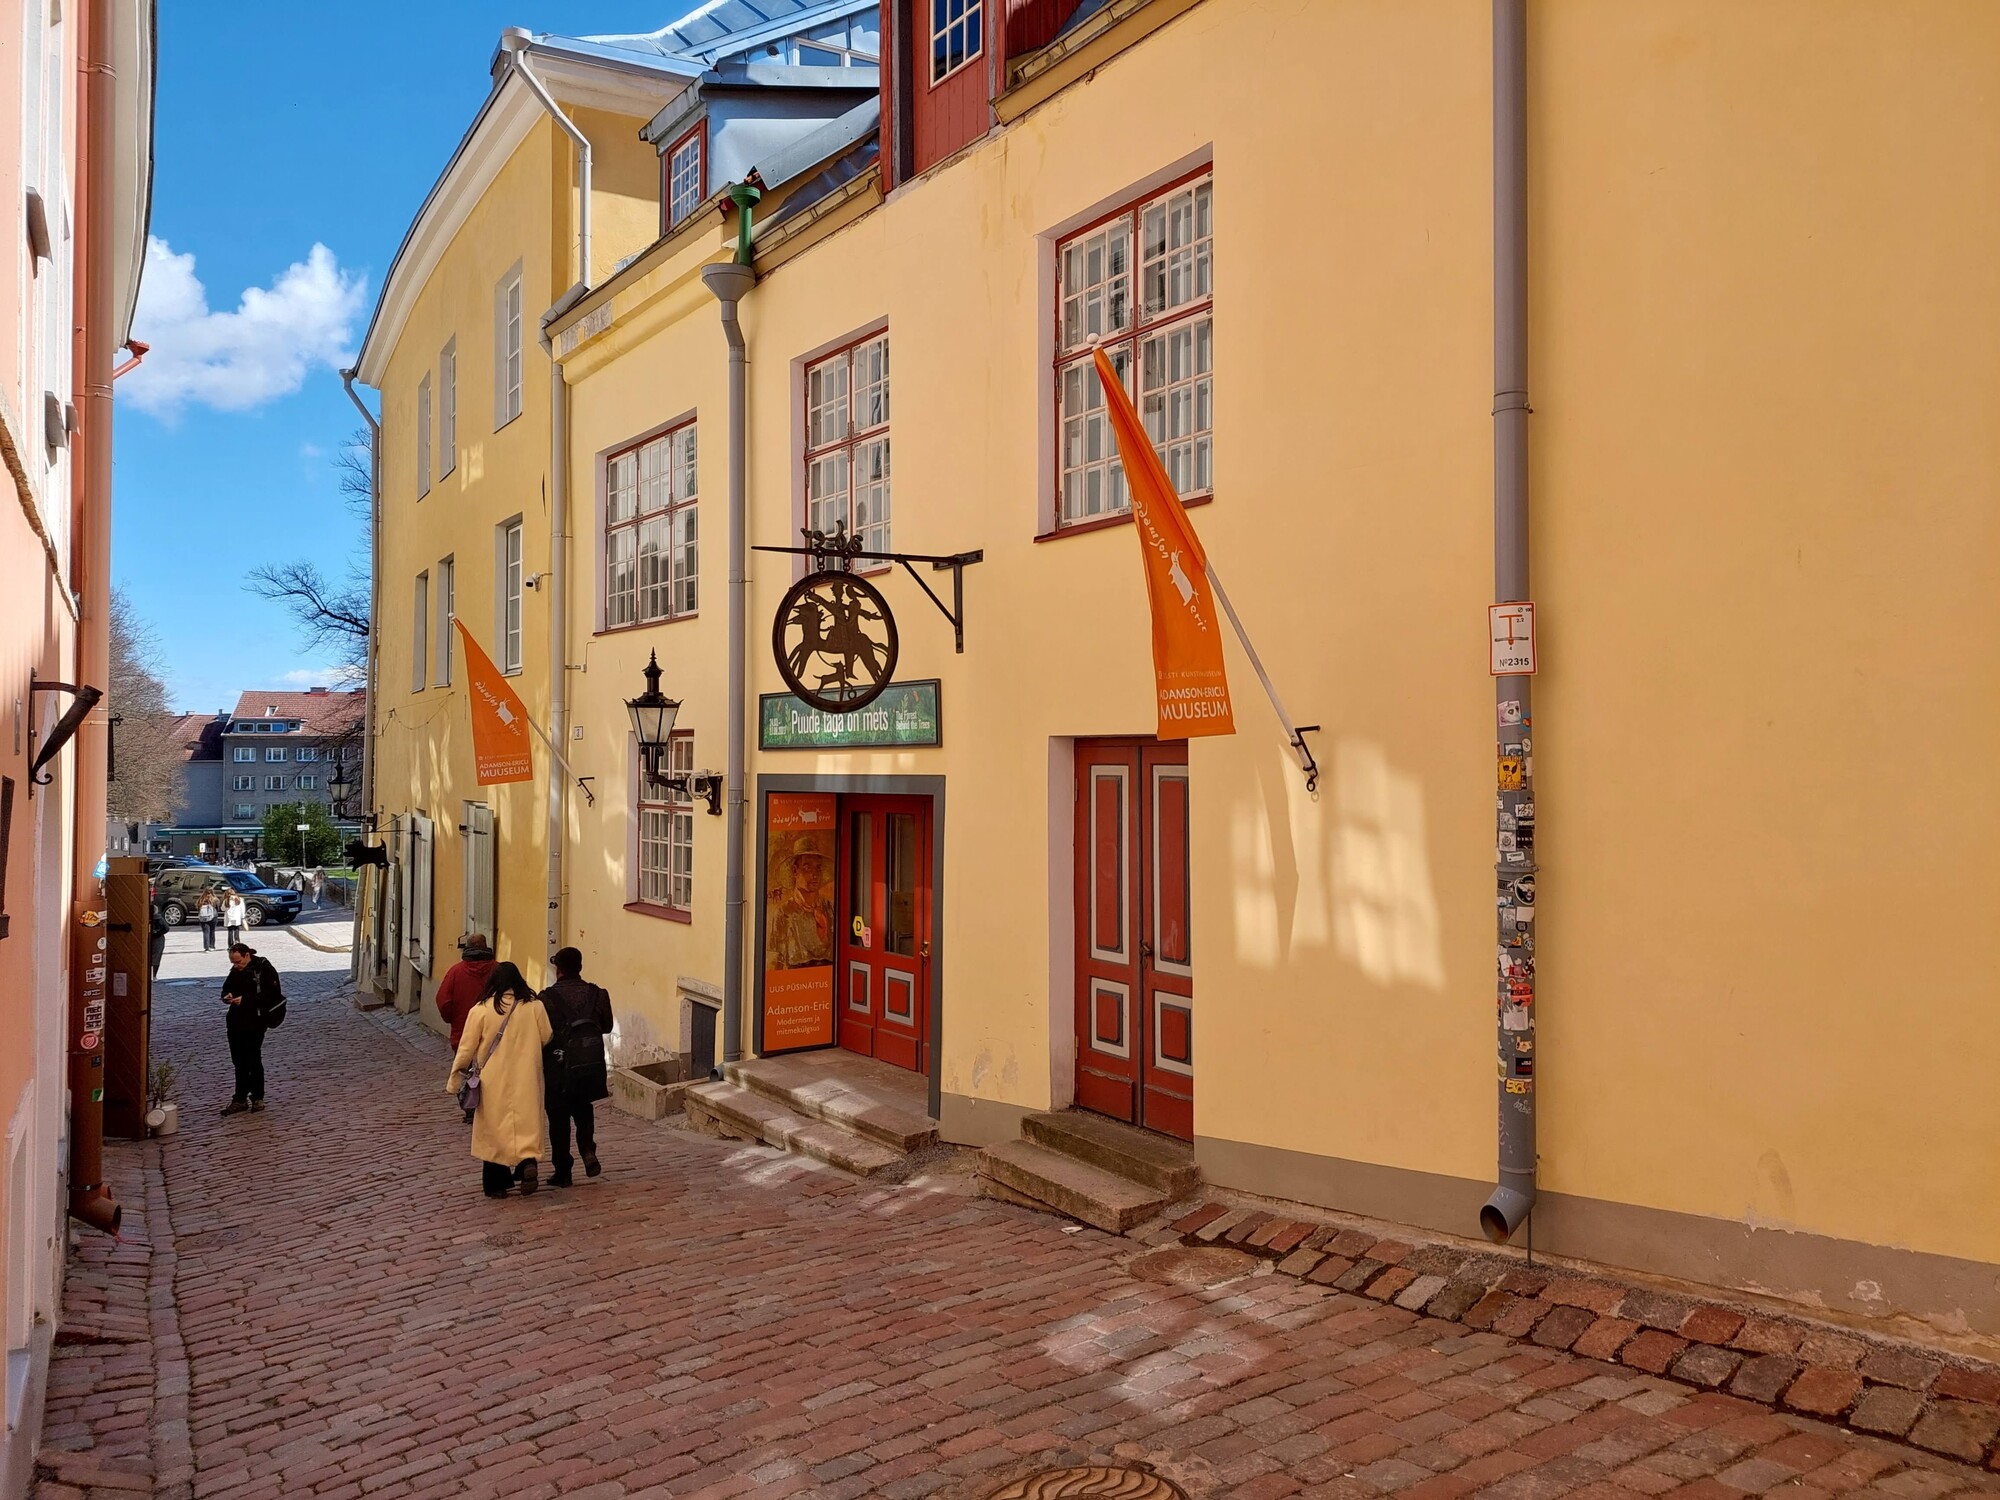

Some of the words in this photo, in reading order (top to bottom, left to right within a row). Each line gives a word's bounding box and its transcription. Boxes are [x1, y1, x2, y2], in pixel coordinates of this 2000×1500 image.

[1160, 686, 1226, 701] ADAMSON-ERICU
[1160, 700, 1229, 721] MUUSEUM
[823, 711, 844, 738] taga
[847, 712, 860, 732] on
[863, 707, 889, 731] mets
[480, 765, 530, 778] MUUSEUM
[769, 985, 785, 993] UUS
[767, 1001, 830, 1016] Adamson-Eric
[776, 1016, 814, 1026] Modernism
